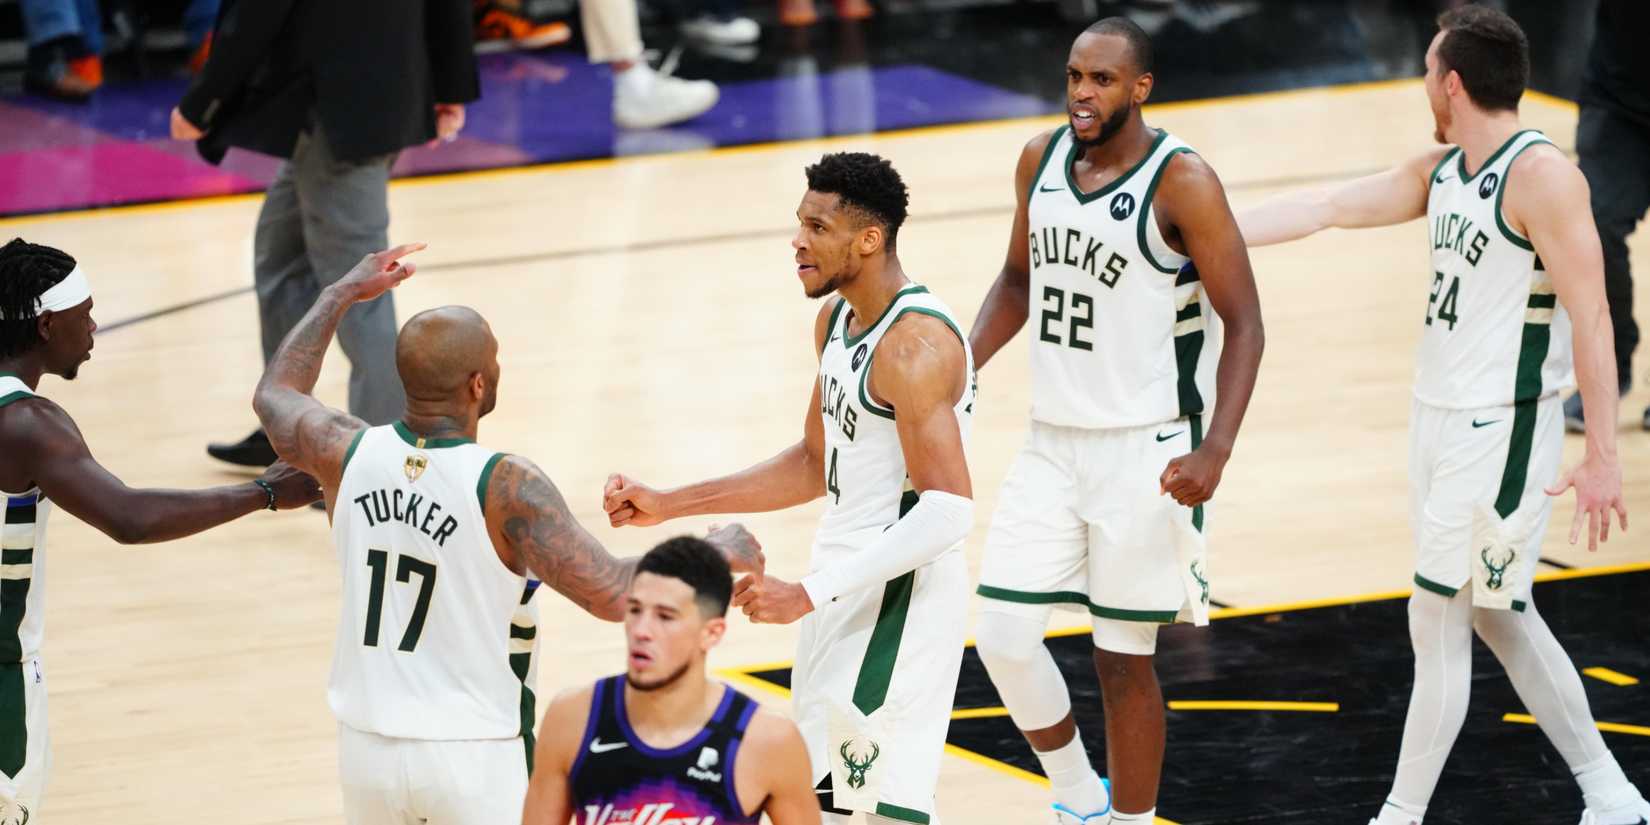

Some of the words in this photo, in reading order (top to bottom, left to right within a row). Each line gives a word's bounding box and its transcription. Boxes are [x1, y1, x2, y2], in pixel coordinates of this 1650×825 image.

[1030, 227, 1128, 289] BUCKS
[1434, 213, 1490, 267] UCKS
[1040, 286, 1093, 351] 22
[820, 374, 858, 442] UCKS
[828, 447, 841, 505] 4
[354, 489, 458, 547] TUCKER
[364, 548, 437, 652] 17
